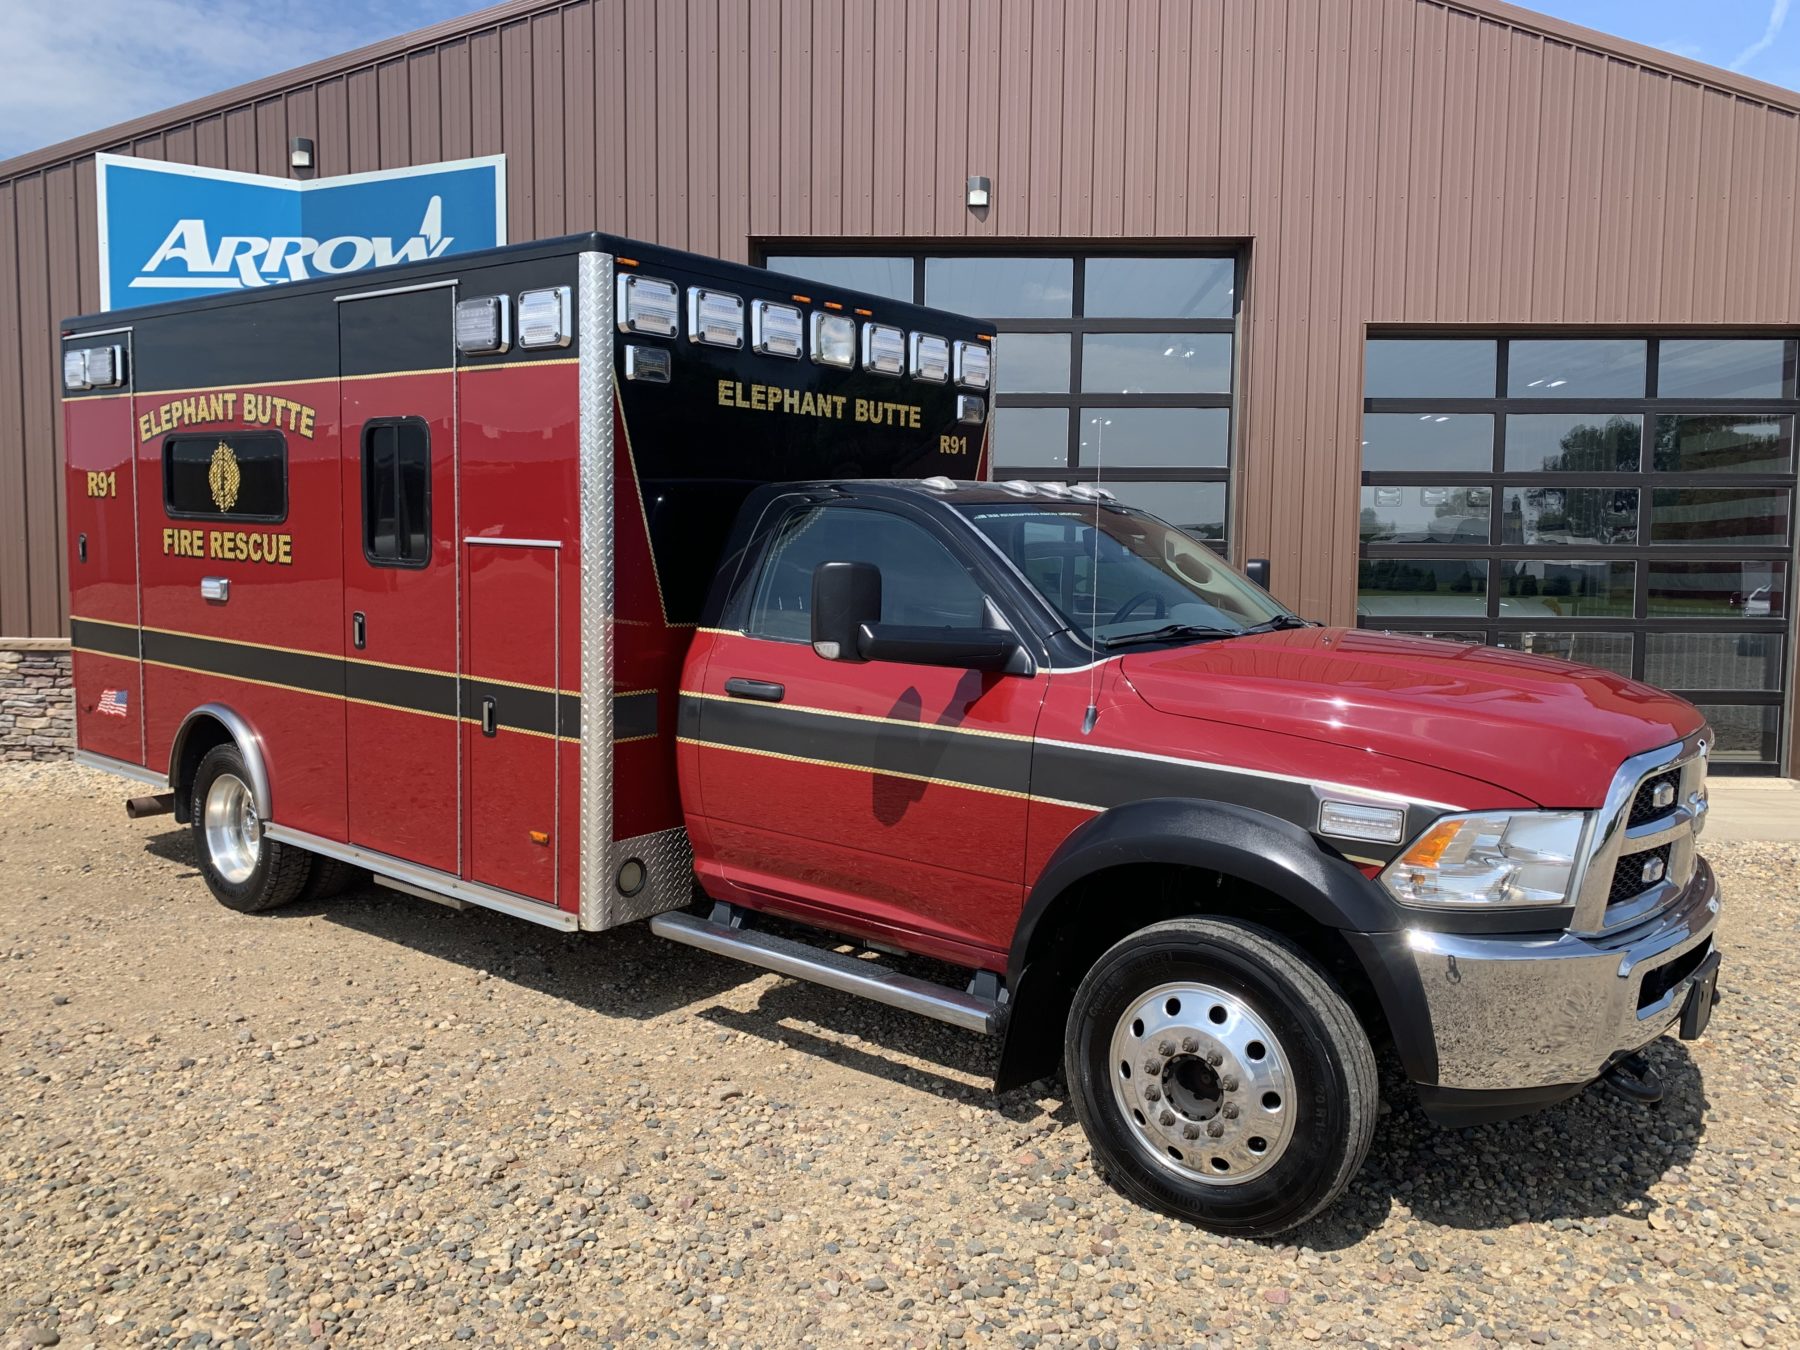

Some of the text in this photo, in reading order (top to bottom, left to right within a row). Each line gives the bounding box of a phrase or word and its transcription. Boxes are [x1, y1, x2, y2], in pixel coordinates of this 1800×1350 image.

[141, 195, 454, 287] ARROW
[138, 392, 316, 442] ELEPHANT BUTTE
[718, 379, 921, 429] ELEPHANT BUTTE
[939, 435, 967, 455] R91
[87, 471, 116, 497] R91
[163, 527, 292, 564] FIRE RESCUE
